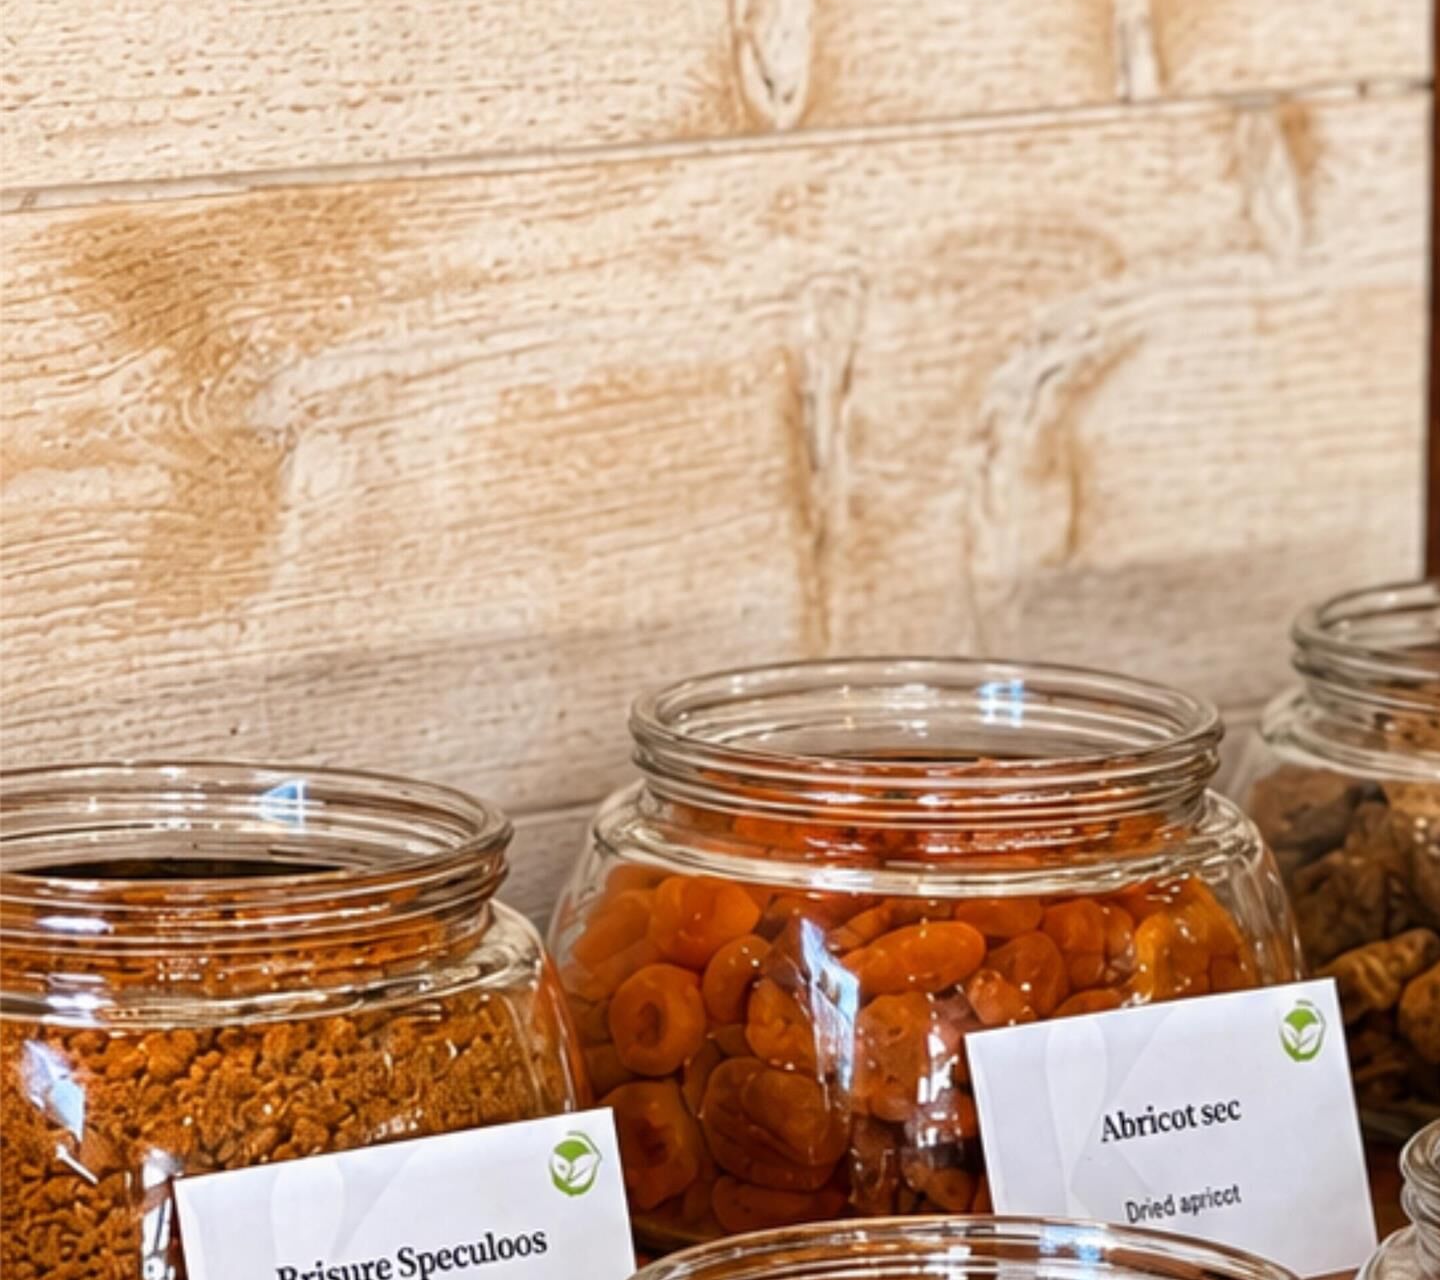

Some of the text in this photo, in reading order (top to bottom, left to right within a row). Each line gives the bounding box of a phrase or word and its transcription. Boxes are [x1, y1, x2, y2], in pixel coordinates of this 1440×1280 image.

[1099, 1098, 1243, 1144] Abricot sec
[1124, 1183, 1243, 1225] Dried apricot
